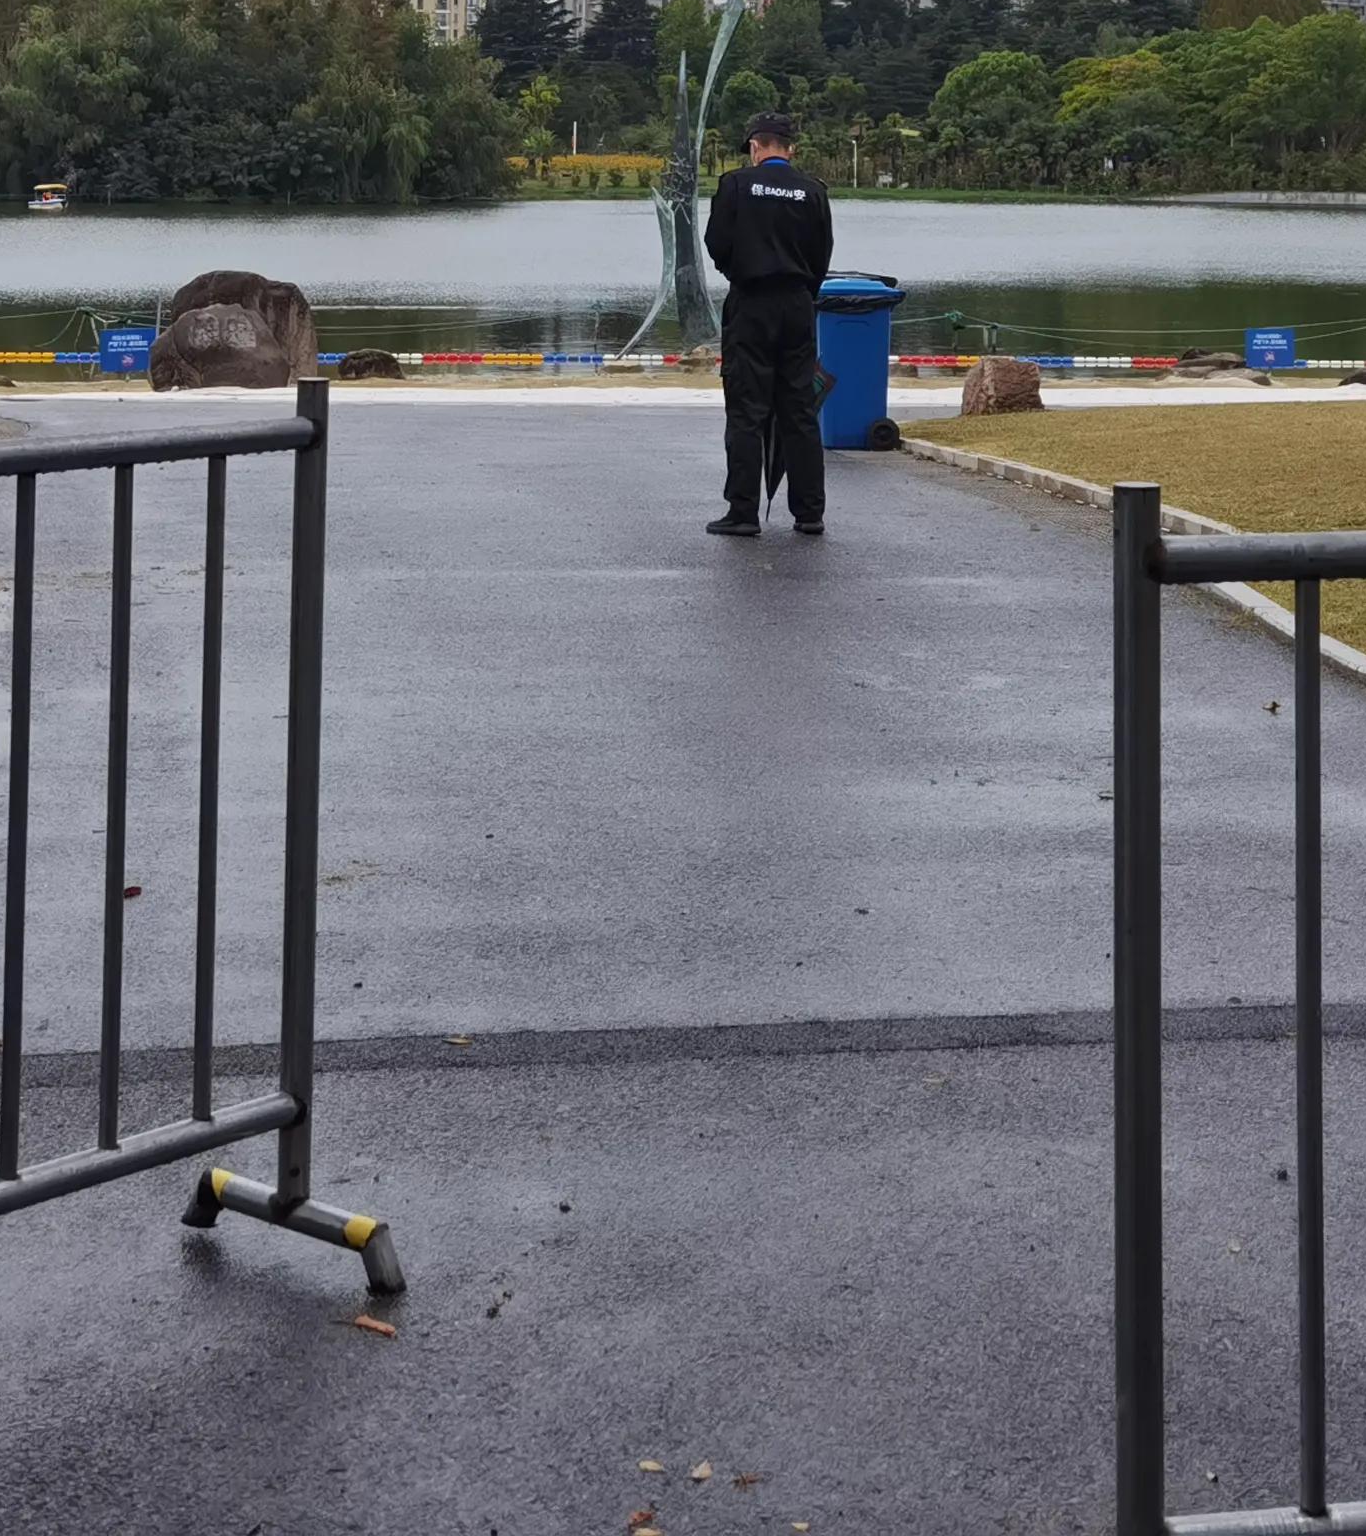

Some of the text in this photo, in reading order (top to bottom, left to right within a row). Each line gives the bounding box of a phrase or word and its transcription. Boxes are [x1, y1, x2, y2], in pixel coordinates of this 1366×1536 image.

[751, 183, 806, 201] 保 BAOAN 安
